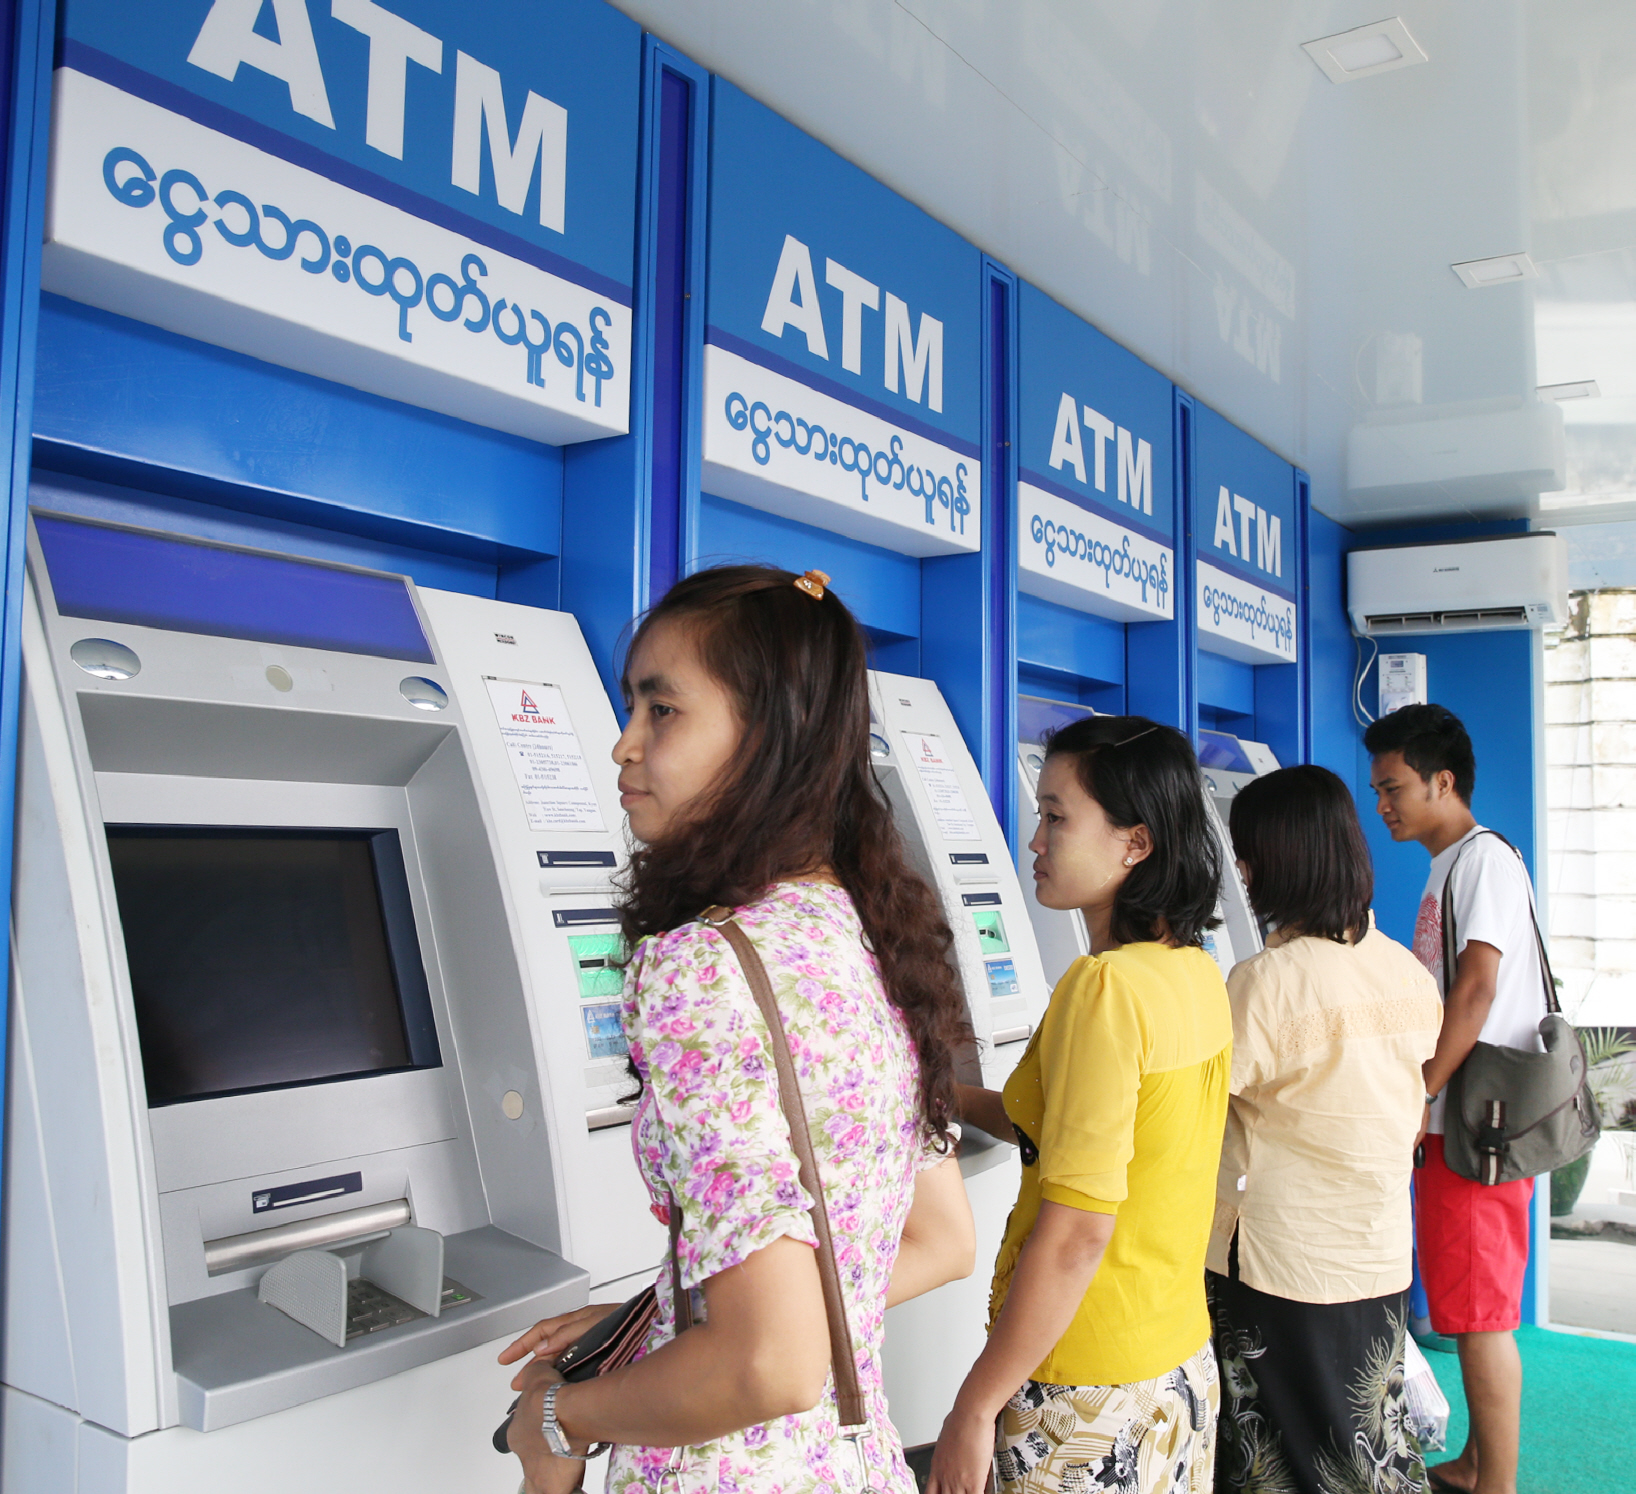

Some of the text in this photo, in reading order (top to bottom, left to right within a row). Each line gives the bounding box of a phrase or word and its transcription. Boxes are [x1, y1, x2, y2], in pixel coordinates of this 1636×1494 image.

[187, 0, 567, 235] ATM
[103, 146, 615, 408] ငွေသားထုတ်ယူရန်
[761, 234, 943, 414] ATM
[725, 392, 970, 535] ငွေသားထုတ်ယူရန်
[1049, 392, 1152, 516] ATM
[1214, 485, 1281, 578] ATM
[511, 713, 556, 724] KBZ BANK
